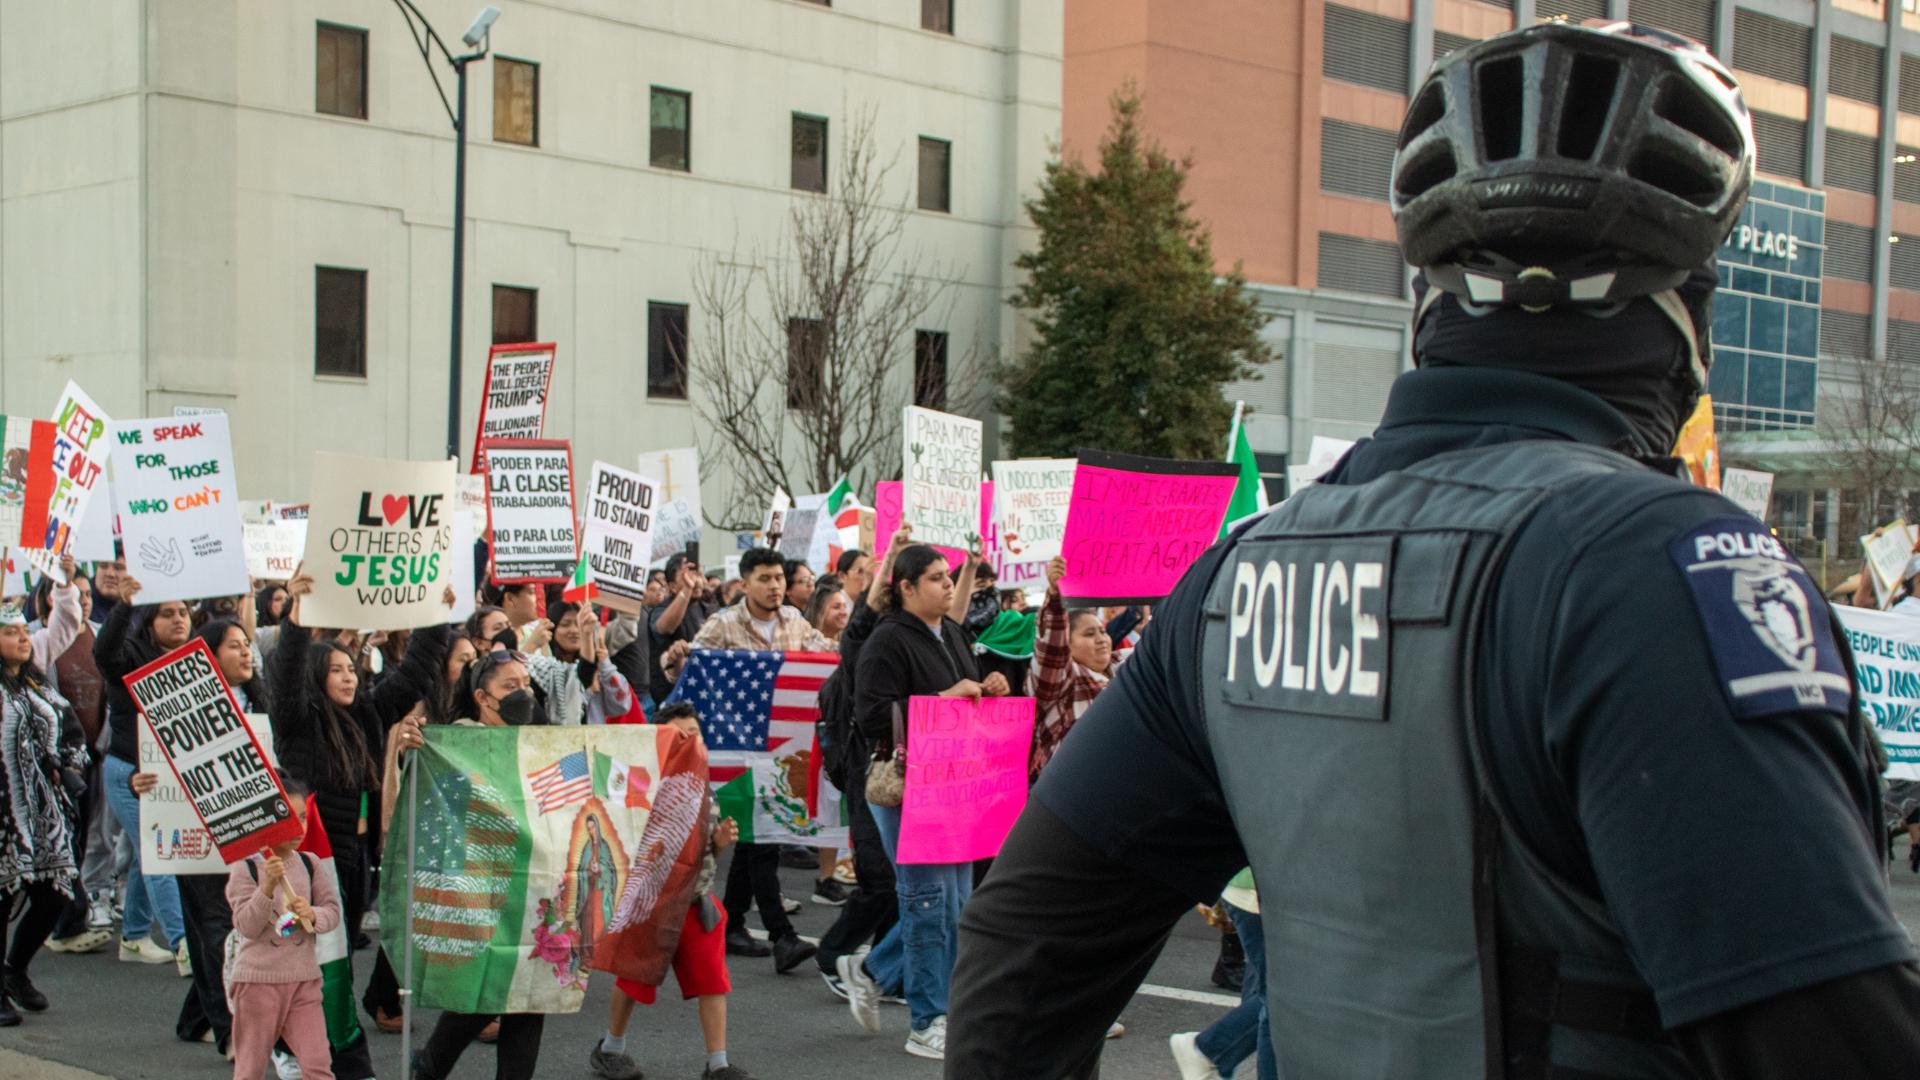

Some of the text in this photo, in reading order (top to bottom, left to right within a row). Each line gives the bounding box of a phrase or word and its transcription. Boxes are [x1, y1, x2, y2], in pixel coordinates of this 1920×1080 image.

[1738, 225, 1798, 260] PLACE
[491, 375, 548, 390] WILL DEFEAT
[493, 360, 549, 376] THE PEOPLE
[488, 389, 546, 410] TRUMP'S
[57, 398, 104, 451] KEEP
[117, 423, 203, 444] WE SPEAK
[484, 415, 540, 432] BILLIONAIRE
[917, 414, 980, 451] PARA MIS
[69, 452, 102, 490] OUT
[136, 454, 166, 469] FOR
[169, 460, 219, 481] THOSE
[535, 457, 568, 470] PARA
[928, 443, 979, 475] PADRES
[488, 474, 570, 492] LA CLASE
[597, 469, 652, 510] PROUD
[1001, 470, 1074, 491] UNDOCUMENTE
[1078, 471, 1224, 507] IMMIGRANTS
[129, 486, 222, 515] WHO CAN'T
[594, 498, 608, 520] TO
[610, 504, 650, 533] STAND
[1030, 509, 1056, 522] THIS
[1073, 507, 1218, 536] MAKE AMERICA
[330, 525, 450, 554] OTHERS AS
[493, 528, 574, 542] NO PARA LOS
[604, 535, 633, 560] WITH
[1694, 533, 1787, 560] POLICE
[335, 553, 440, 586] JESUS
[1069, 539, 1145, 578] GREAT
[357, 585, 426, 605] WOULD
[1227, 560, 1383, 697] POLICE
[132, 650, 212, 707] WORKERS
[1798, 685, 1820, 698] NC
[1856, 663, 1883, 694] ND
[147, 676, 225, 727] SHOULD HAVE
[157, 697, 242, 760] POWER
[181, 742, 266, 799] NOT THE
[196, 773, 276, 818] BILLIONAIRES!
